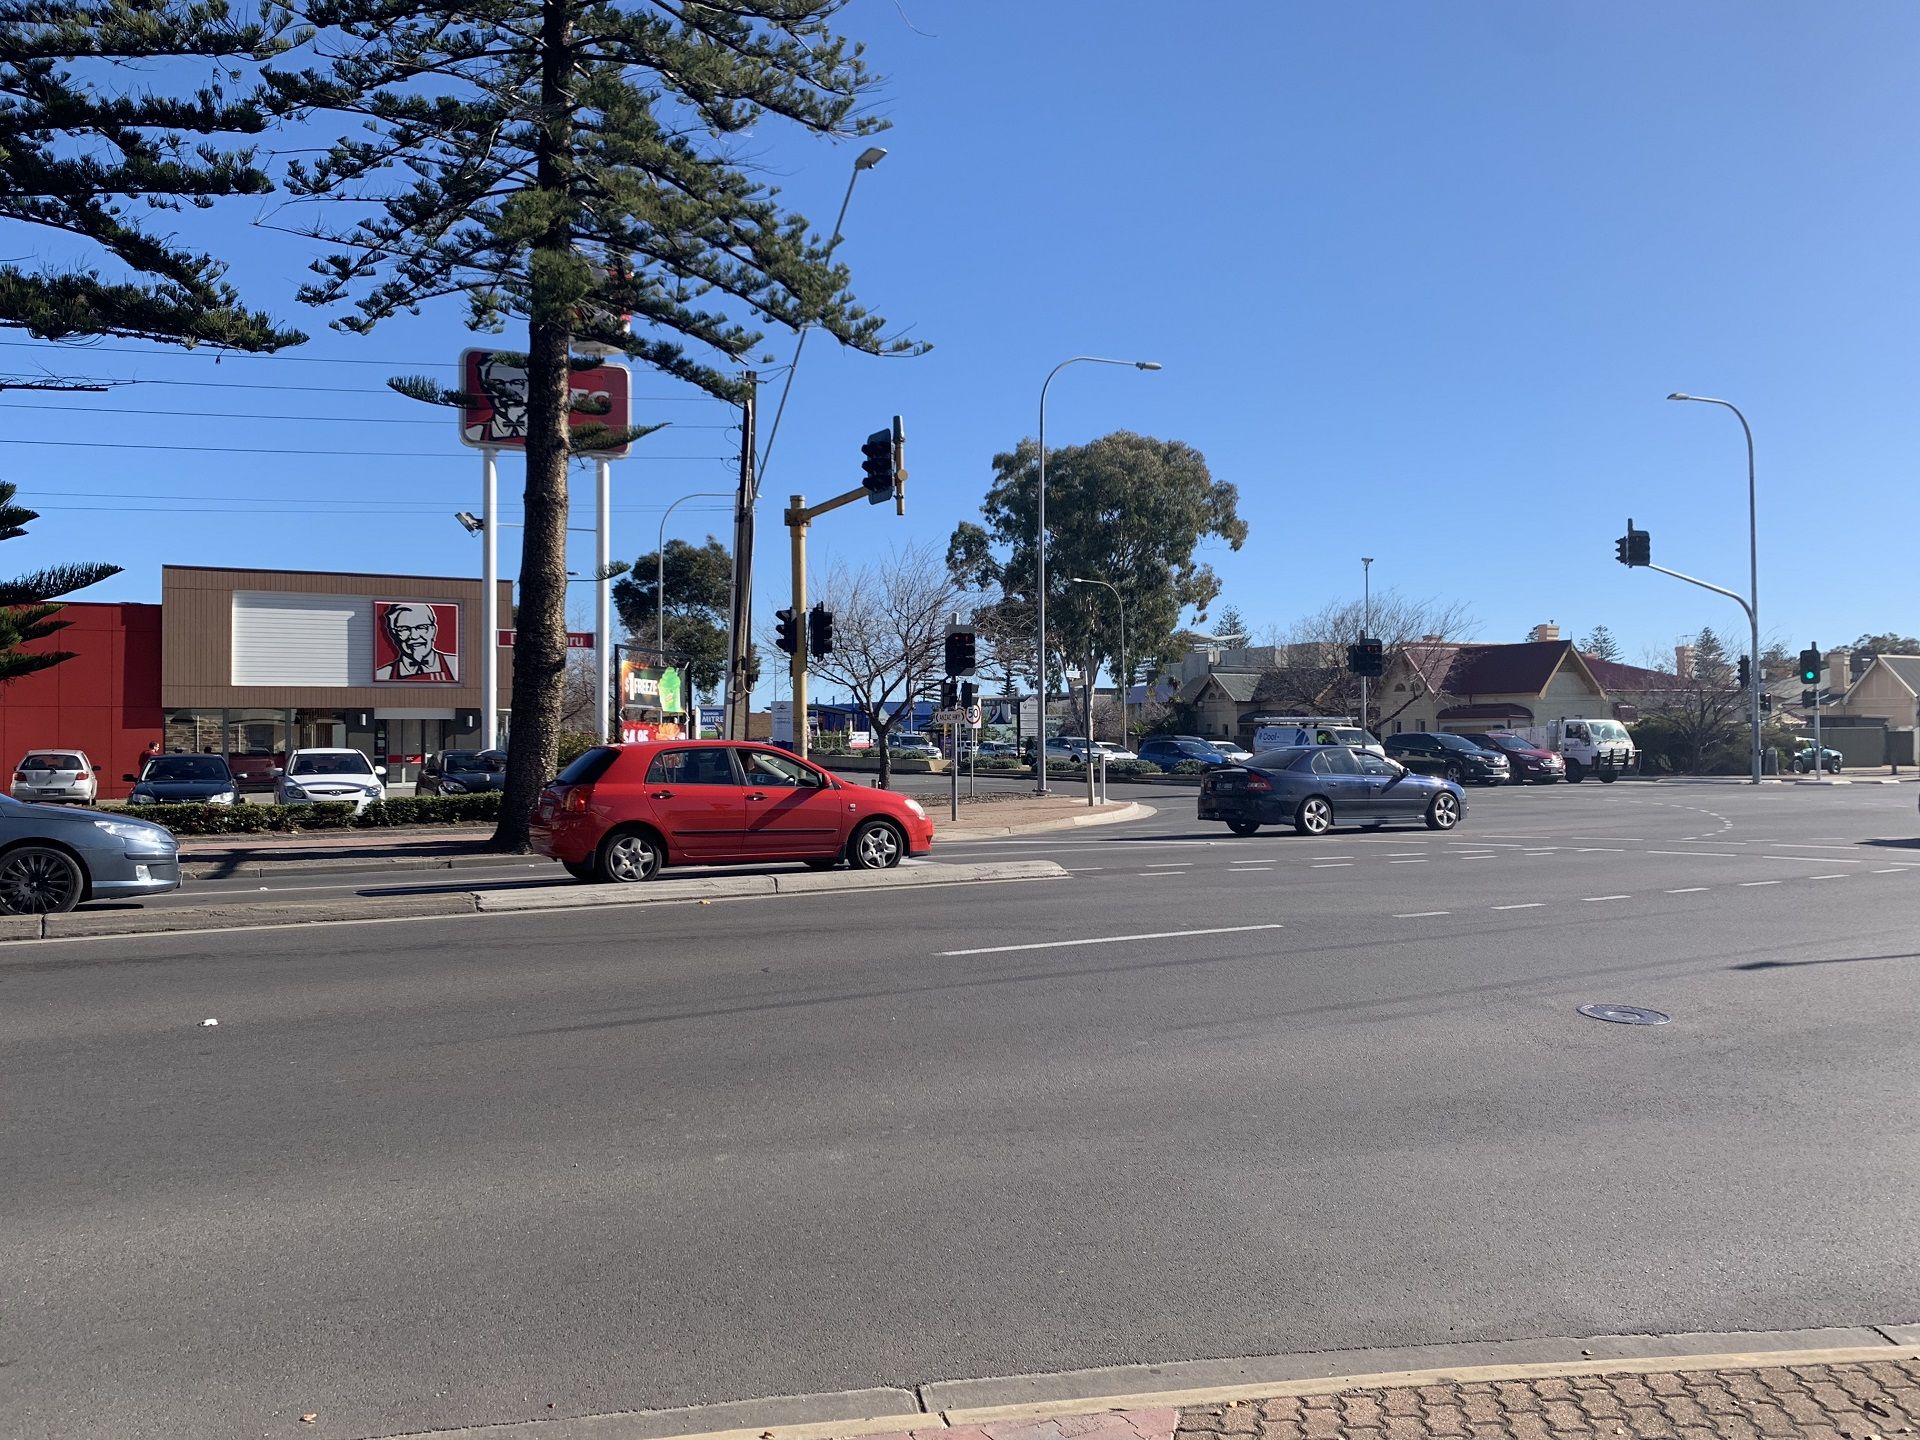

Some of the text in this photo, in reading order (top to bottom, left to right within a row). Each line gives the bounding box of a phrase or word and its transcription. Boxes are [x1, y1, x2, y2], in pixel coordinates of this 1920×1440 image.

[624, 672, 658, 700] $1 FREEZE
[968, 708, 979, 719] 50
